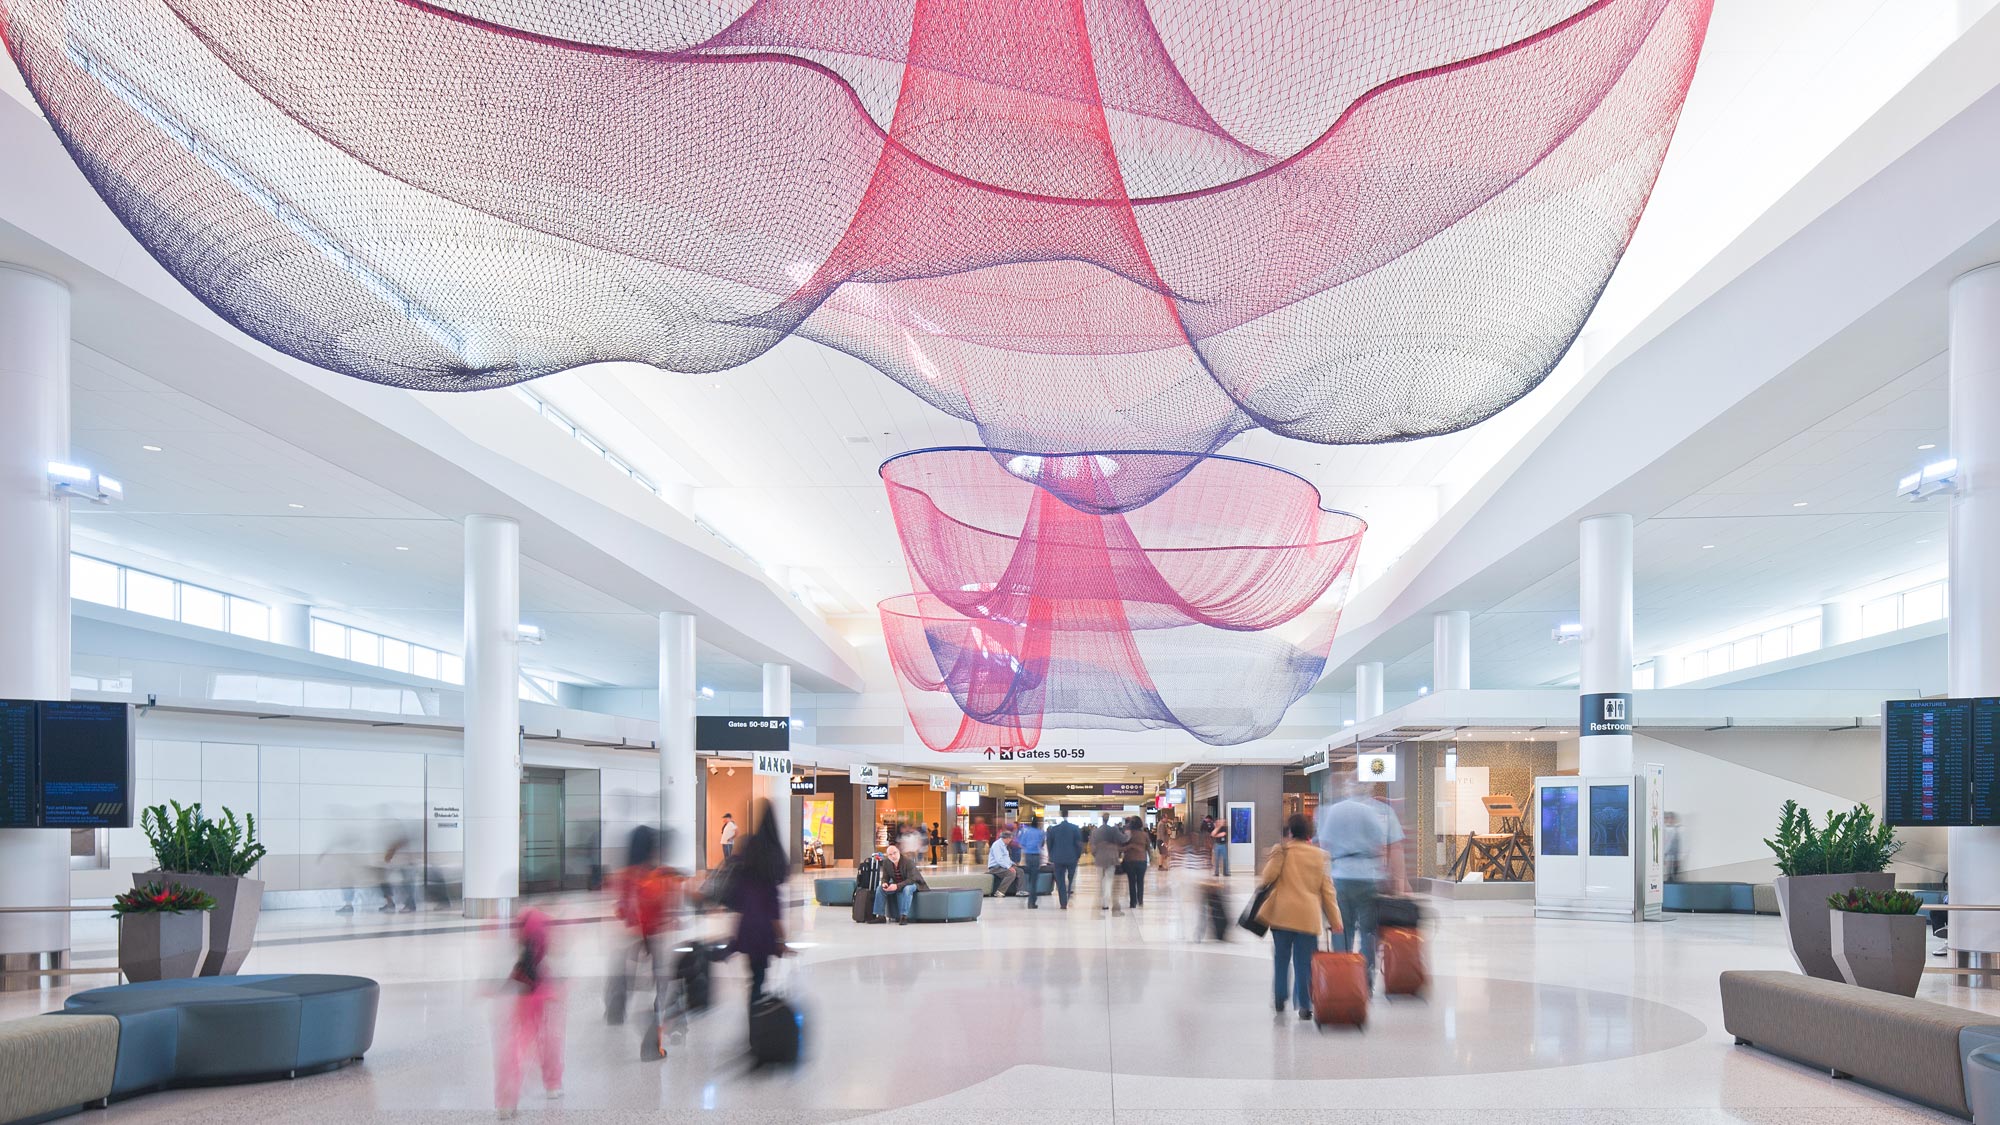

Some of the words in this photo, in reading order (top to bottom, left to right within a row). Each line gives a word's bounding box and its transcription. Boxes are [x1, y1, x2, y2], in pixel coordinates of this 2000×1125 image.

[1017, 749, 1050, 759] Gates
[1053, 749, 1085, 759] 50-59
[760, 755, 792, 774] MANGO
